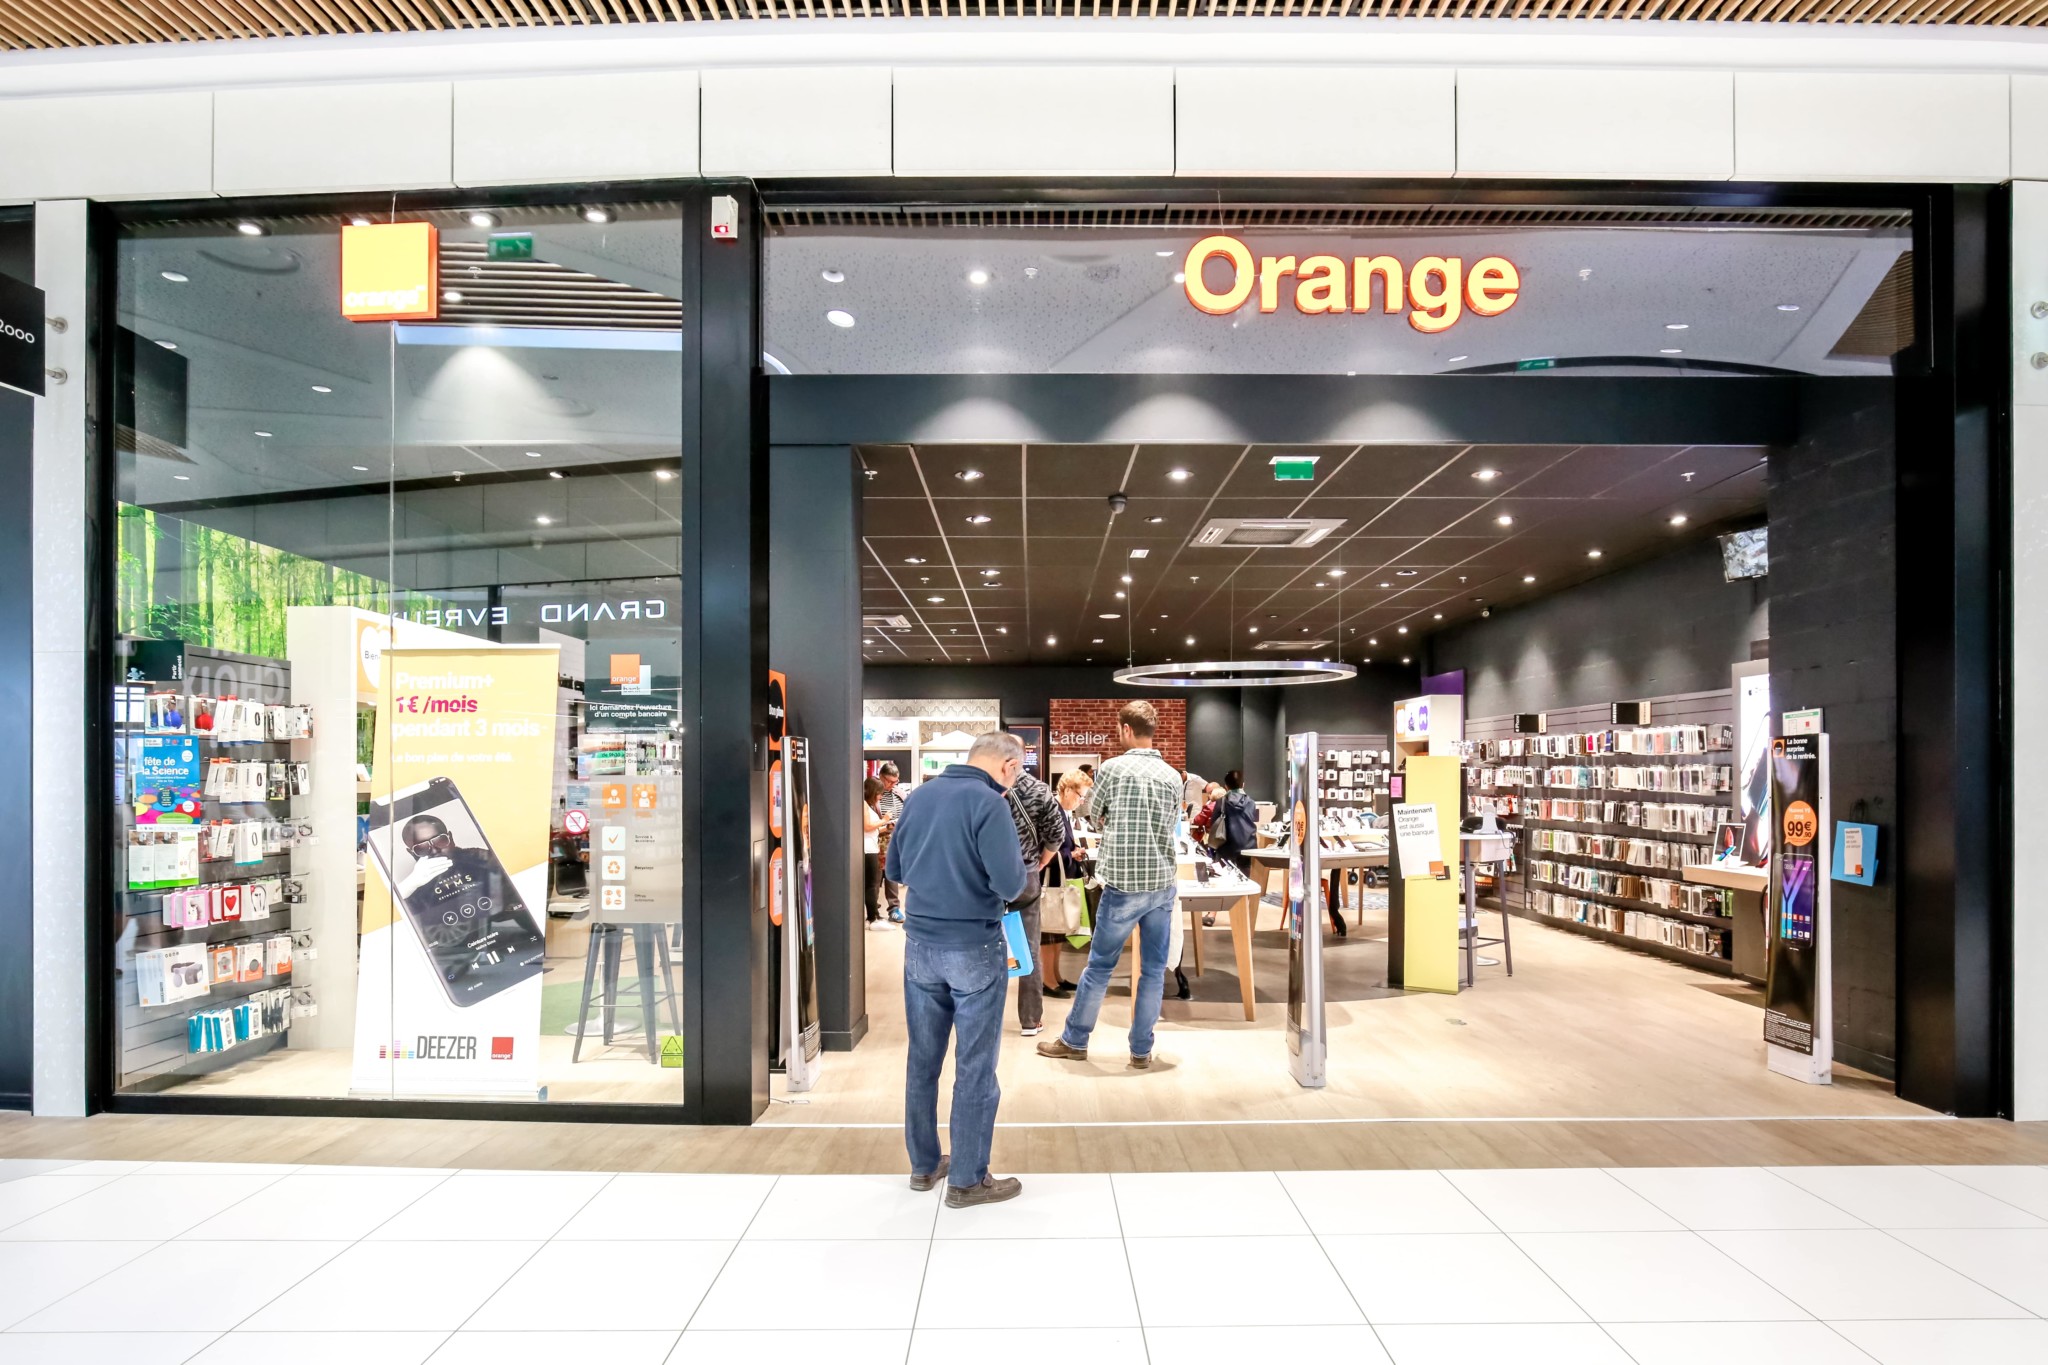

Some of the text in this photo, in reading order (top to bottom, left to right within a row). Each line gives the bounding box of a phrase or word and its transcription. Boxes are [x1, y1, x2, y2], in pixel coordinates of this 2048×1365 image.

[1184, 235, 1520, 333] Orange
[395, 671, 496, 690] Premium+
[611, 711, 636, 719] compte
[391, 718, 471, 741] pendant
[475, 718, 488, 737] 3
[1049, 731, 1108, 746] L'atelier
[144, 756, 176, 766] fête de
[405, 752, 425, 762] bon
[427, 752, 449, 765] plan
[450, 752, 464, 762] de
[142, 765, 190, 776] la Science
[1397, 807, 1433, 816] Maintenant
[1412, 829, 1435, 837] banque
[434, 874, 472, 894] GIMS
[416, 1035, 477, 1060] DEEZER
